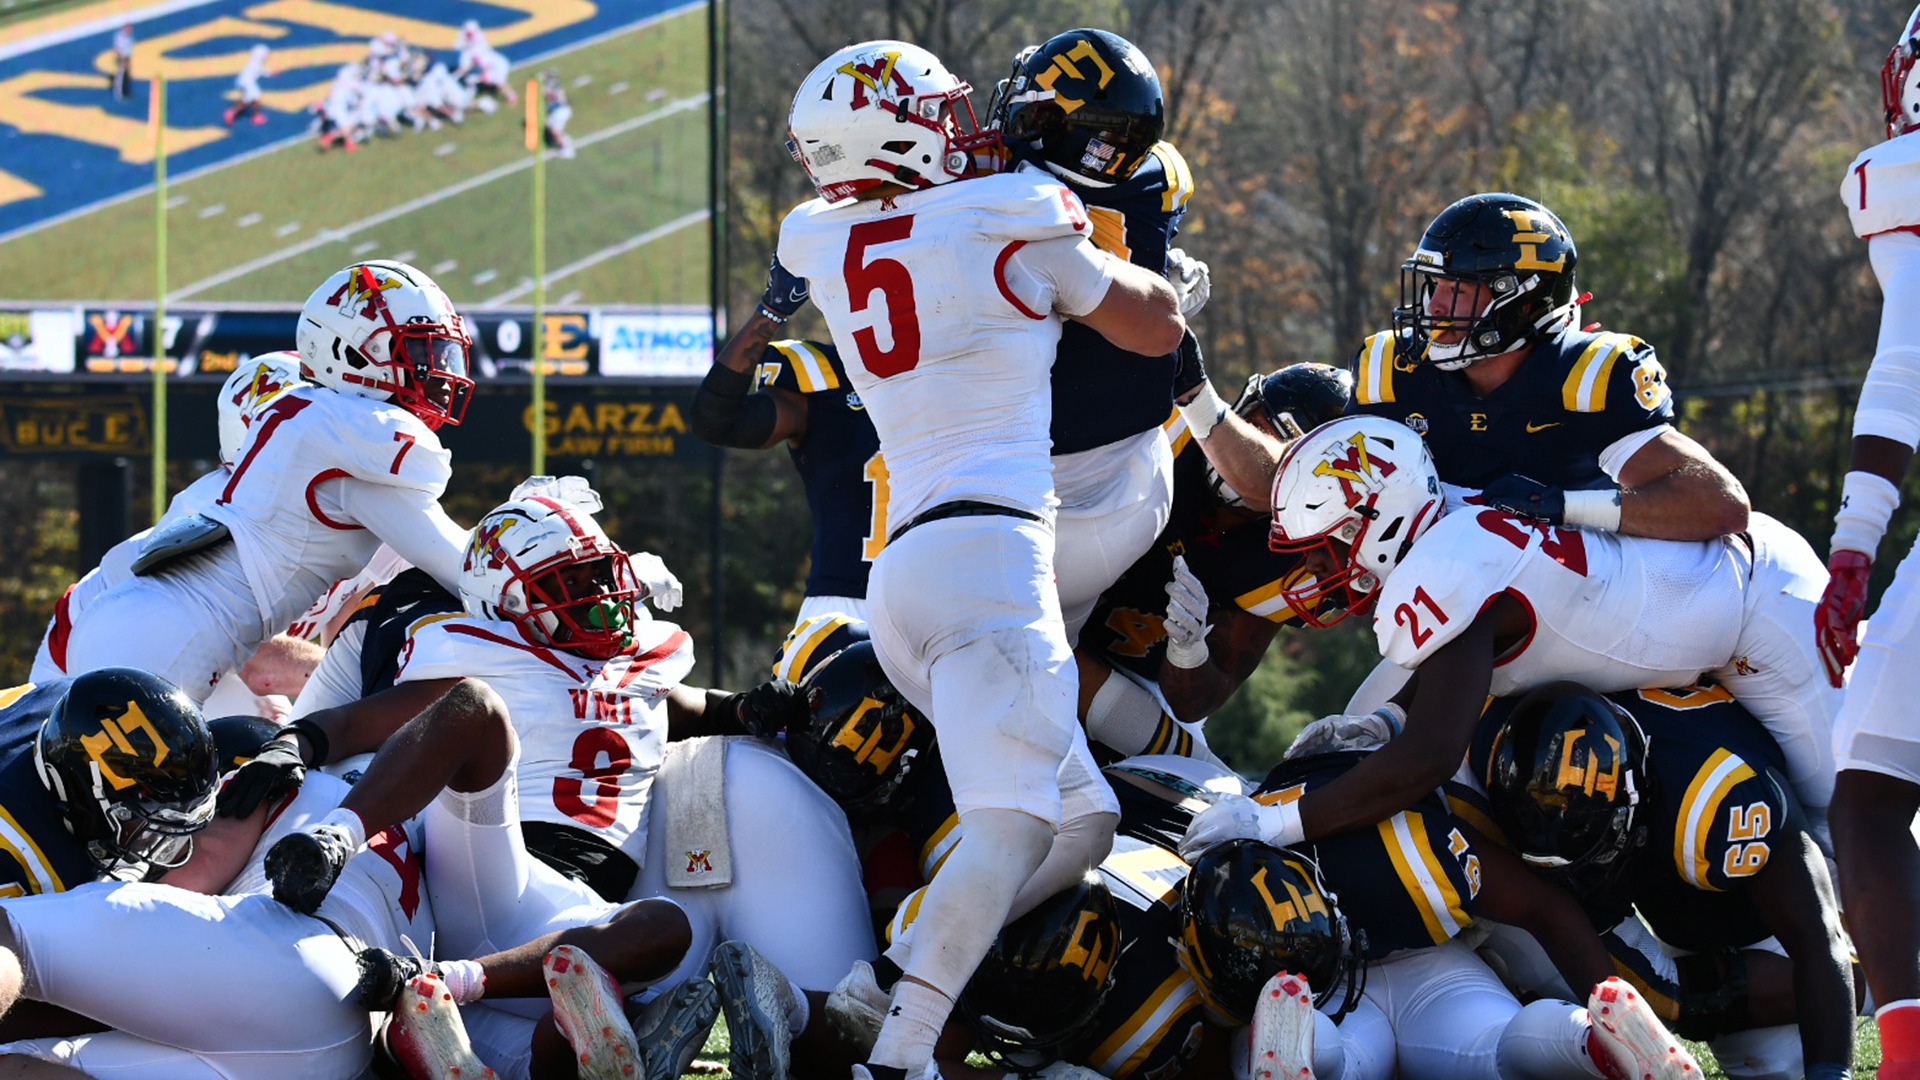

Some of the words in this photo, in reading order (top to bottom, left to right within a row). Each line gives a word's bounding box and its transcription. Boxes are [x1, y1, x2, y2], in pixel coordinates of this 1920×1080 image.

[843, 213, 920, 379] 5
[162, 316, 182, 350] 7
[497, 319, 521, 352] 0
[522, 401, 687, 435] GARZA
[389, 432, 416, 475] 7
[606, 436, 675, 455] FIRM
[1394, 585, 1449, 650] 21
[568, 688, 633, 725] VMI
[1722, 801, 1772, 878] 65
